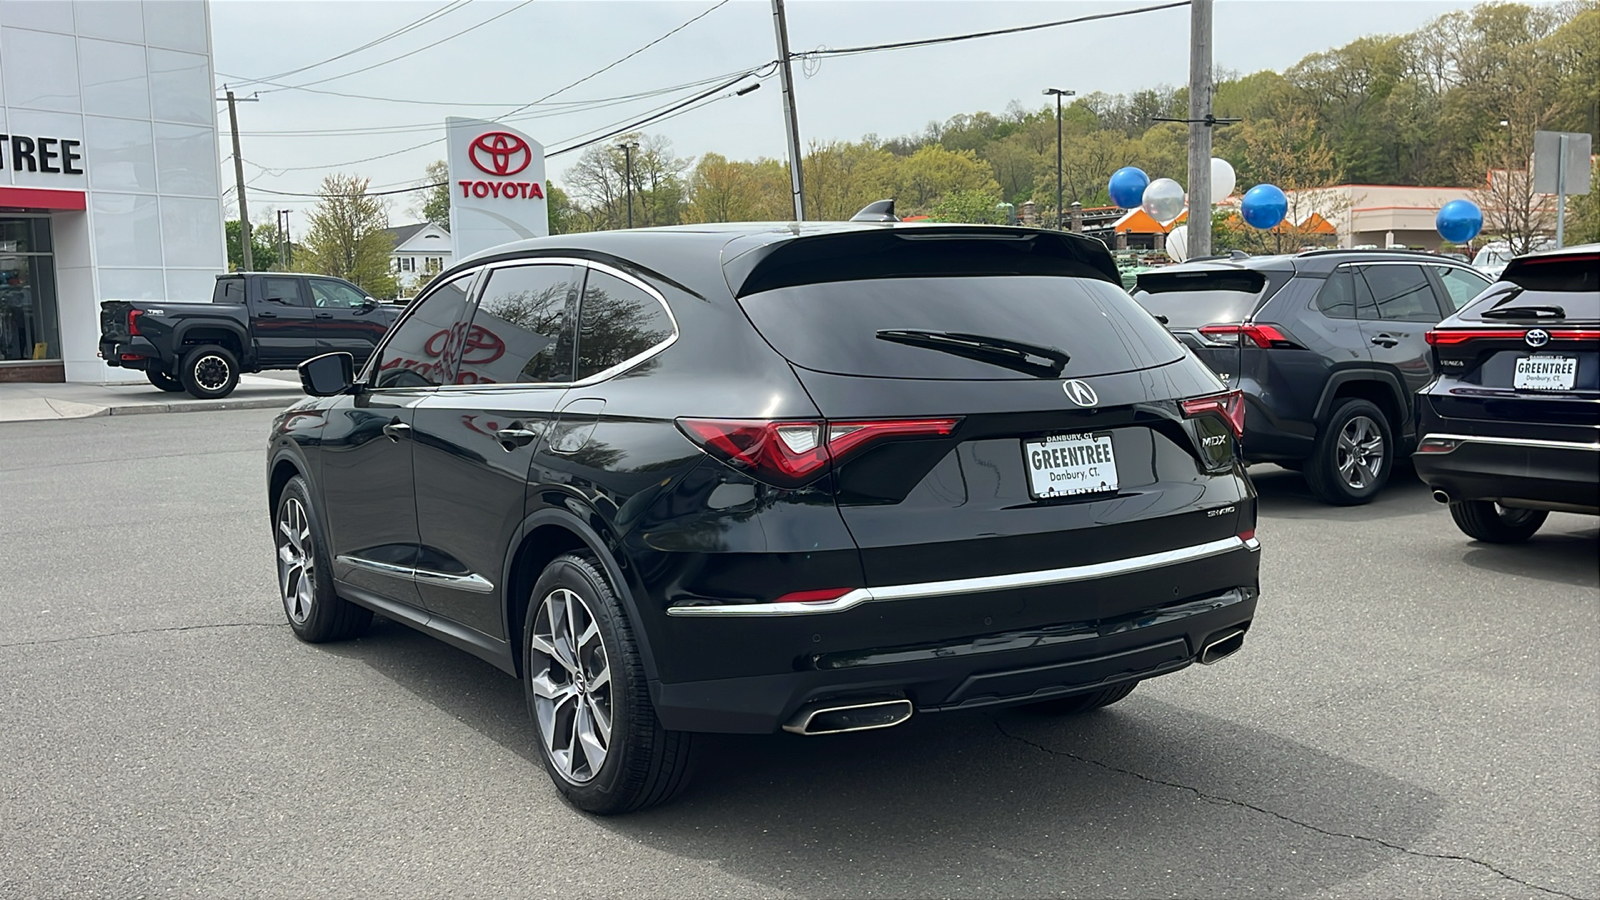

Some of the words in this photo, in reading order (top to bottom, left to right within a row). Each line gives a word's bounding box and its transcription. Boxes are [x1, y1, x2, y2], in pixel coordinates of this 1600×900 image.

[458, 181, 544, 199] TOYOTA
[1518, 362, 1573, 374] GREENTREE
[1202, 434, 1226, 448] MDX
[1031, 443, 1111, 471] GREENTREE
[1049, 469, 1088, 482] Danbury,
[1088, 467, 1100, 477] CT.
[1039, 484, 1119, 498] GREENTREE
